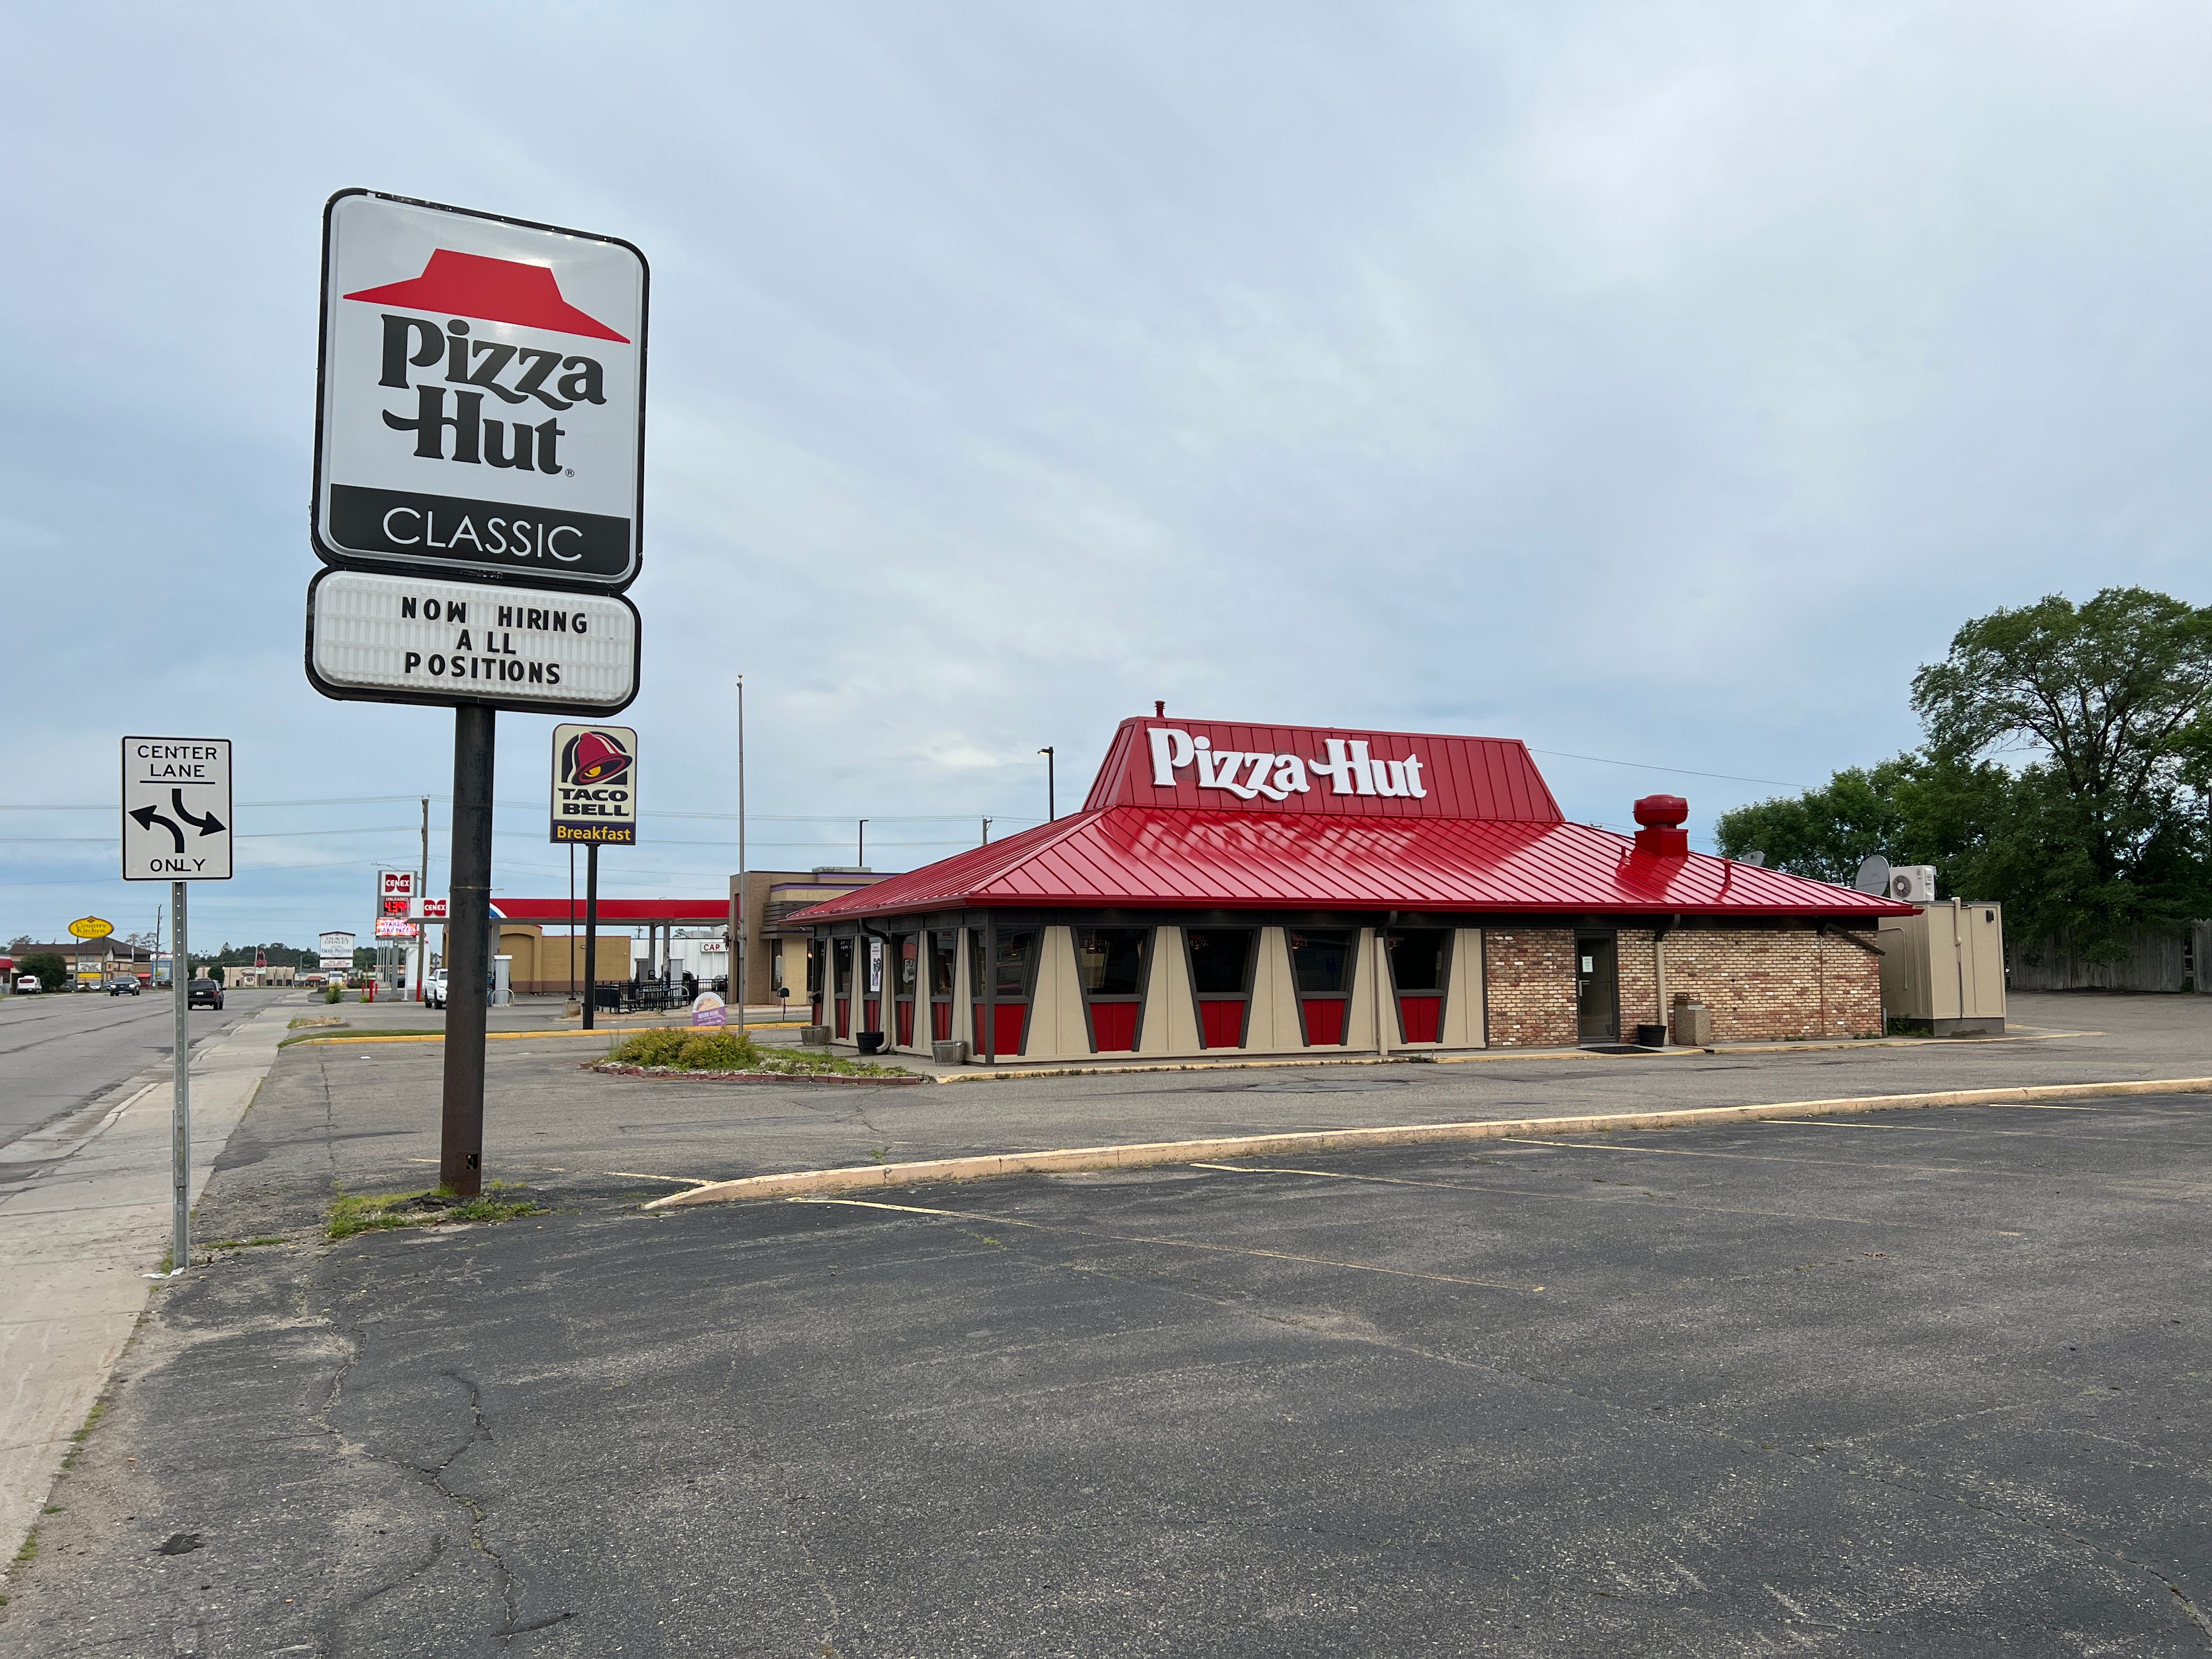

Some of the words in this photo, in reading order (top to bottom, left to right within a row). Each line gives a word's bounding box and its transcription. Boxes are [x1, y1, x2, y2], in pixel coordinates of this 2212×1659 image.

[379, 313, 607, 410] Pizza
[382, 384, 566, 475] Hut
[383, 507, 583, 562] CLASSIC
[402, 596, 466, 623] NOW
[498, 605, 587, 634] HIRING
[456, 629, 516, 654] ALL
[405, 652, 560, 684] POSITIONS
[137, 745, 217, 760] CENTER
[1147, 727, 1311, 802] Pizza
[1308, 738, 1427, 798] Hut
[150, 764, 205, 777] LANE
[557, 788, 628, 802] TACO
[562, 803, 629, 816] BELL
[557, 825, 631, 841] Breakfast
[150, 859, 206, 872] ONLY
